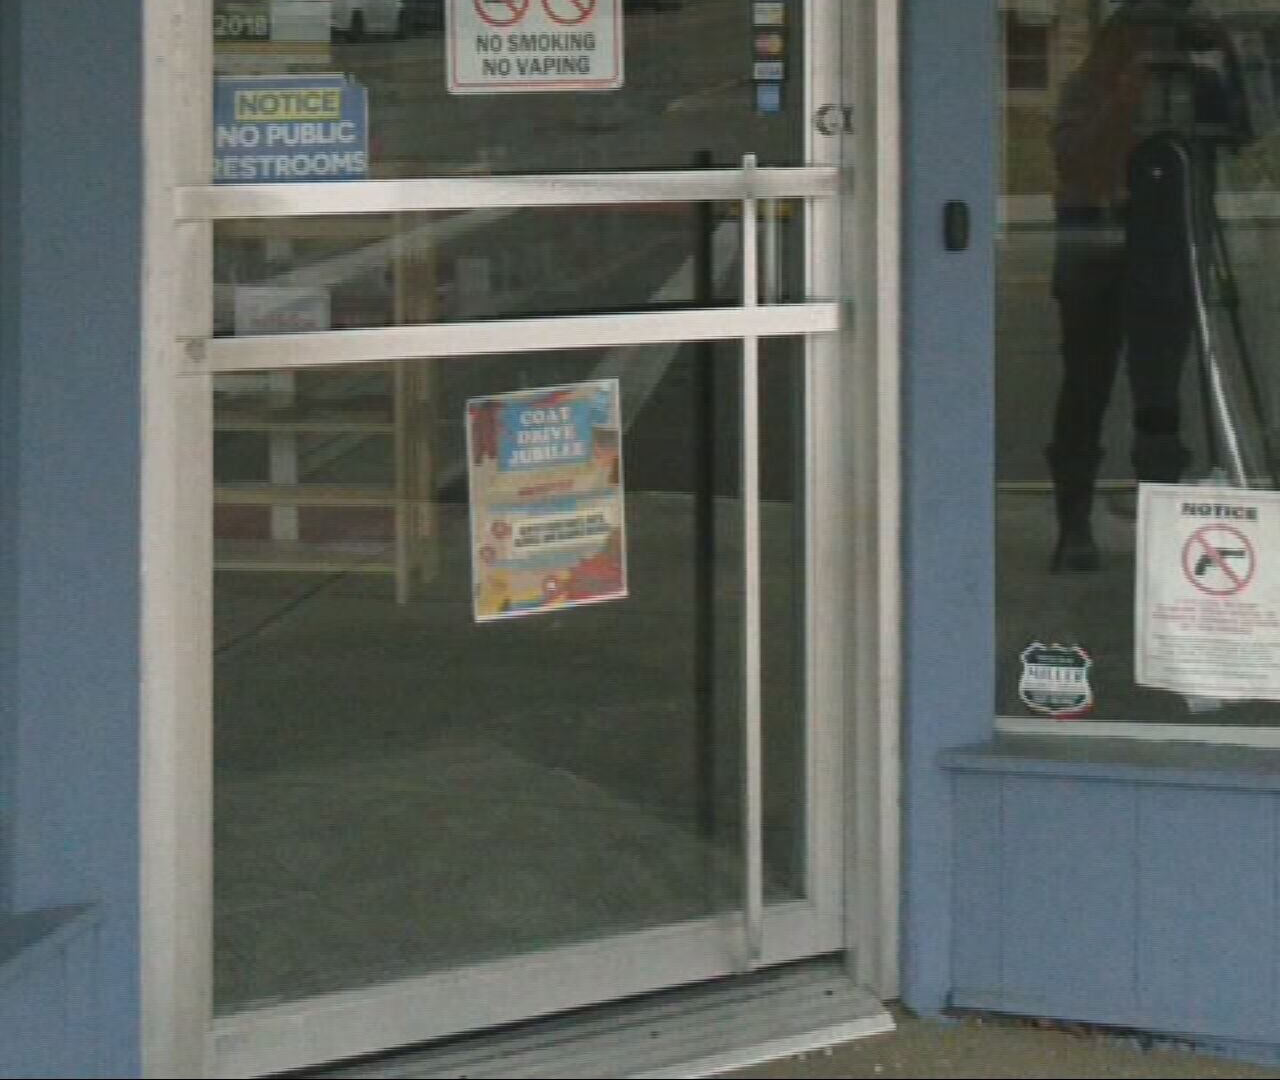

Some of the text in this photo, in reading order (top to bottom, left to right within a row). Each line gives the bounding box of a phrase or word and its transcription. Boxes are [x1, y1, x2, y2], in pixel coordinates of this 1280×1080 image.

[475, 31, 596, 54] NO SMOKING
[481, 54, 592, 77] NO VAPING
[238, 89, 339, 116] NOTICE
[216, 122, 357, 148] NO PUBLIC
[519, 406, 571, 425] COAT
[516, 427, 577, 445] DRIVE
[1181, 502, 1256, 520] NOTICE
